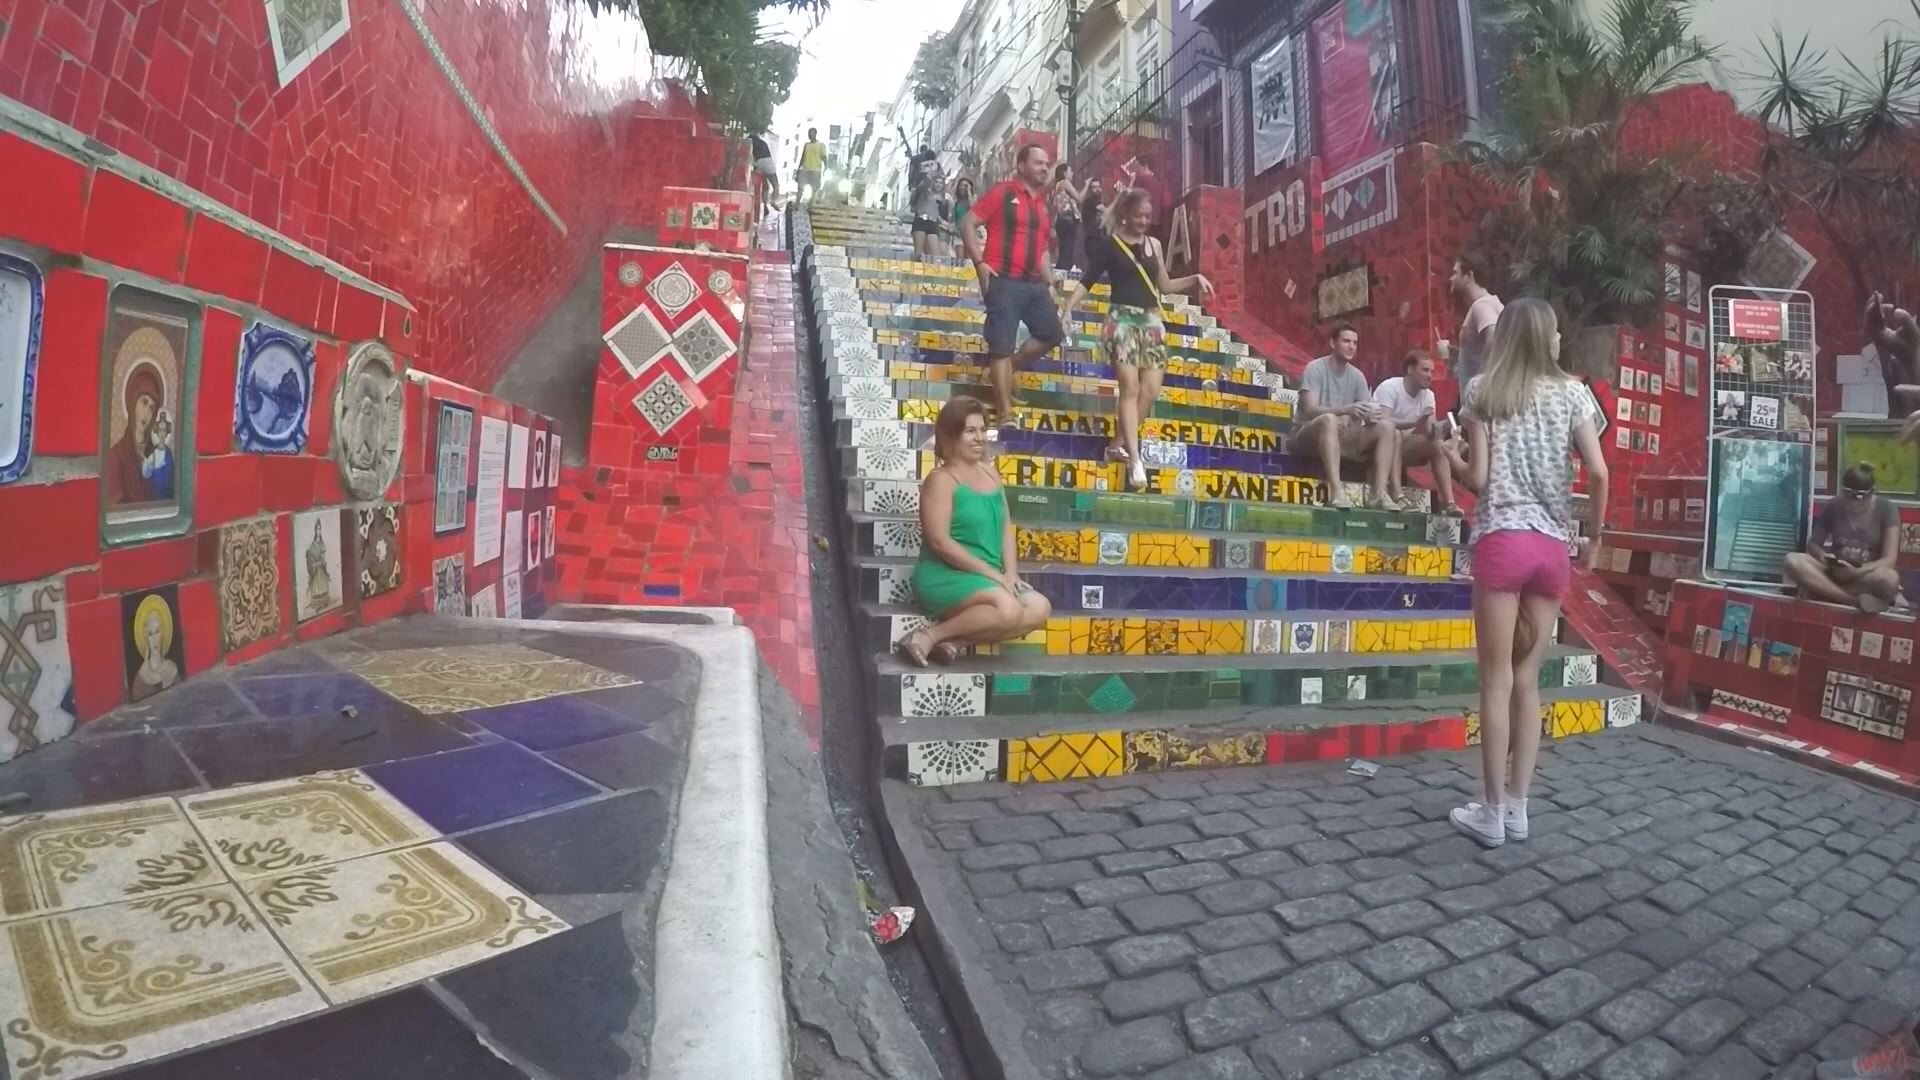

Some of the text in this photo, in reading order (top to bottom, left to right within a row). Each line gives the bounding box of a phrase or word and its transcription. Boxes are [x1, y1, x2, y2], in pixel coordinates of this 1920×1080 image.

[1245, 178, 1305, 254] TRO
[1752, 416, 1776, 428] SALE
[1017, 457, 1078, 489] RIO
[1205, 474, 1330, 506] JANEIRO
